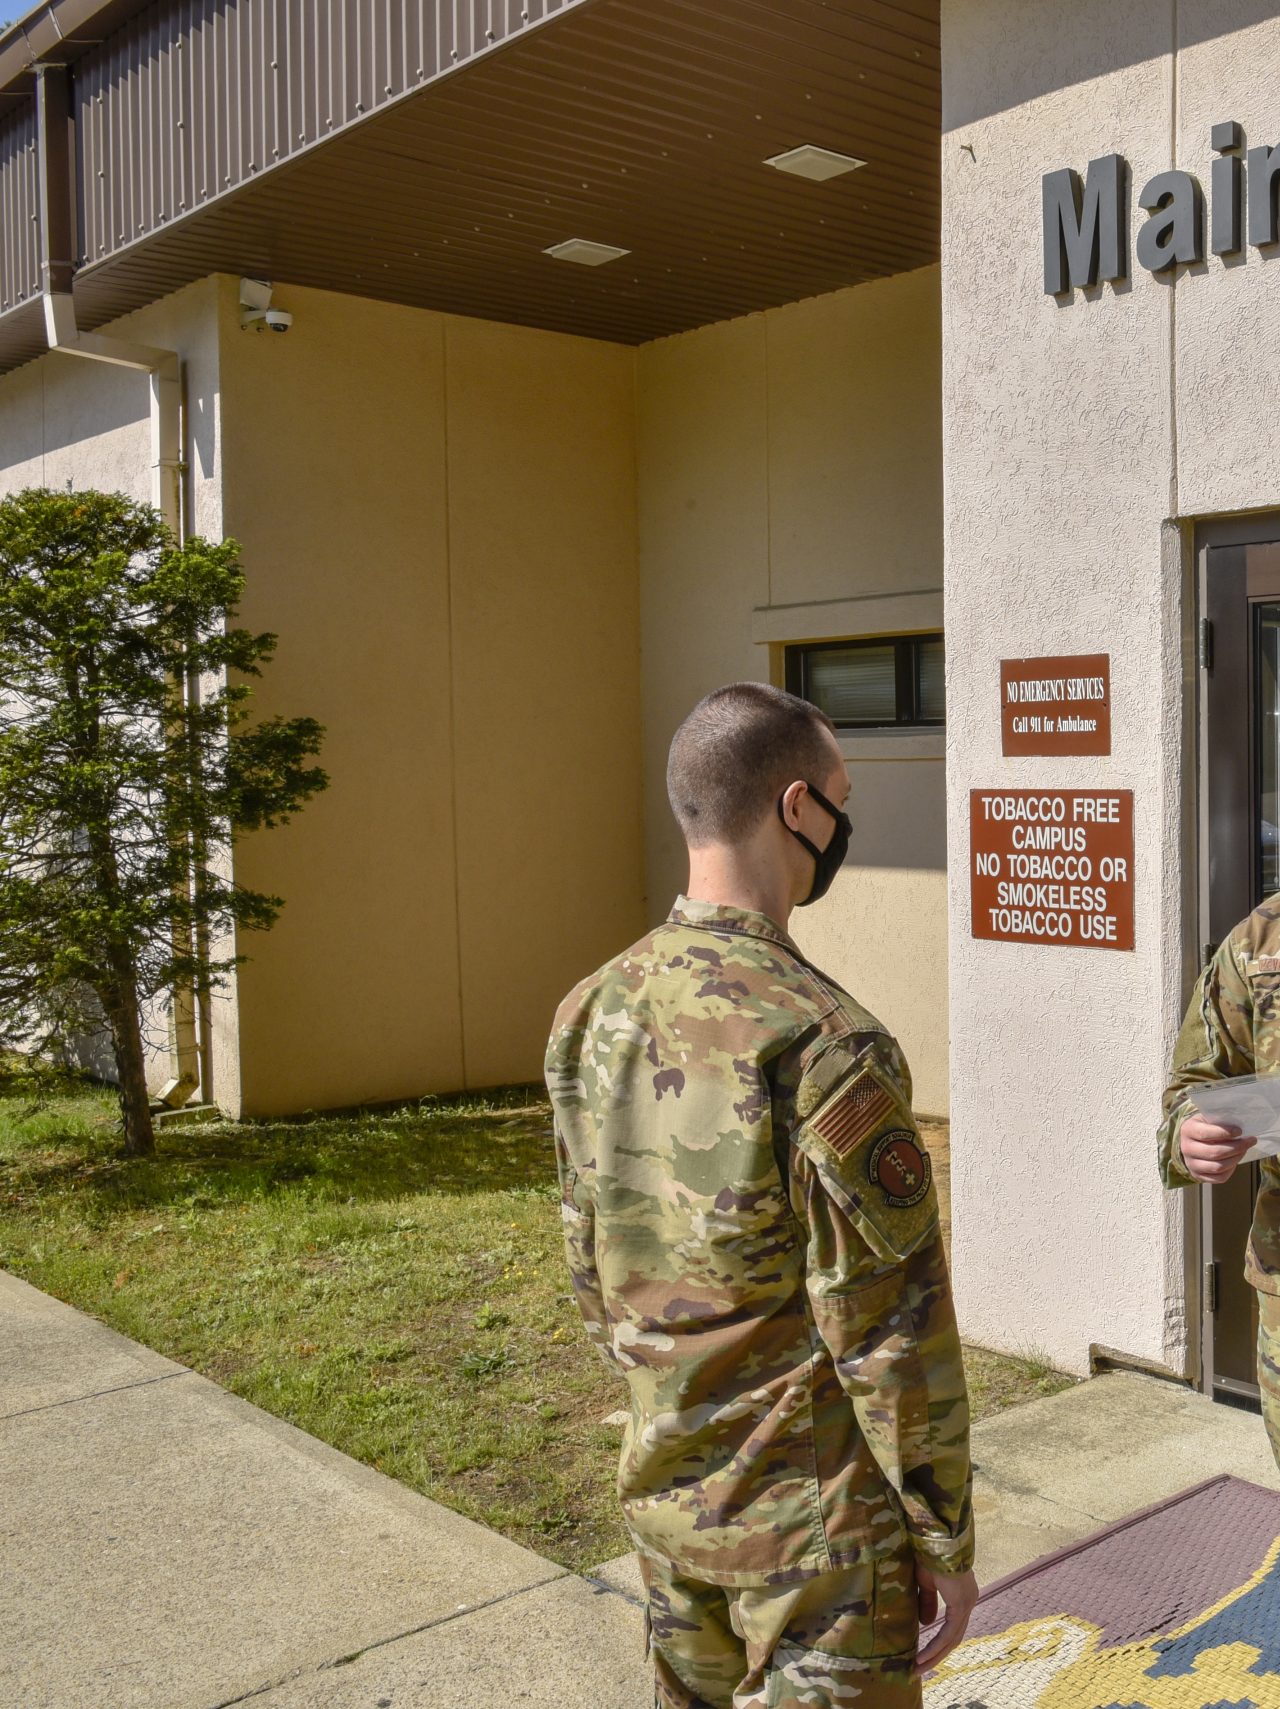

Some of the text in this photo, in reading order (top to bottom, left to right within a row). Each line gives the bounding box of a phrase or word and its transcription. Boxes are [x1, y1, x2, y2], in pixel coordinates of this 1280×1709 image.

[1007, 677, 1104, 703] NO EMERGENCY SERVICES
[1013, 715, 1096, 733] Call 911 for Ambulance
[982, 797, 1120, 823] TOBACCO FREE
[1012, 825, 1086, 852] CAMPUS
[976, 853, 1127, 882] NO TOBACCO OR
[997, 881, 1107, 912] SMOKELESS
[989, 908, 1117, 941] TOBACCO USE
